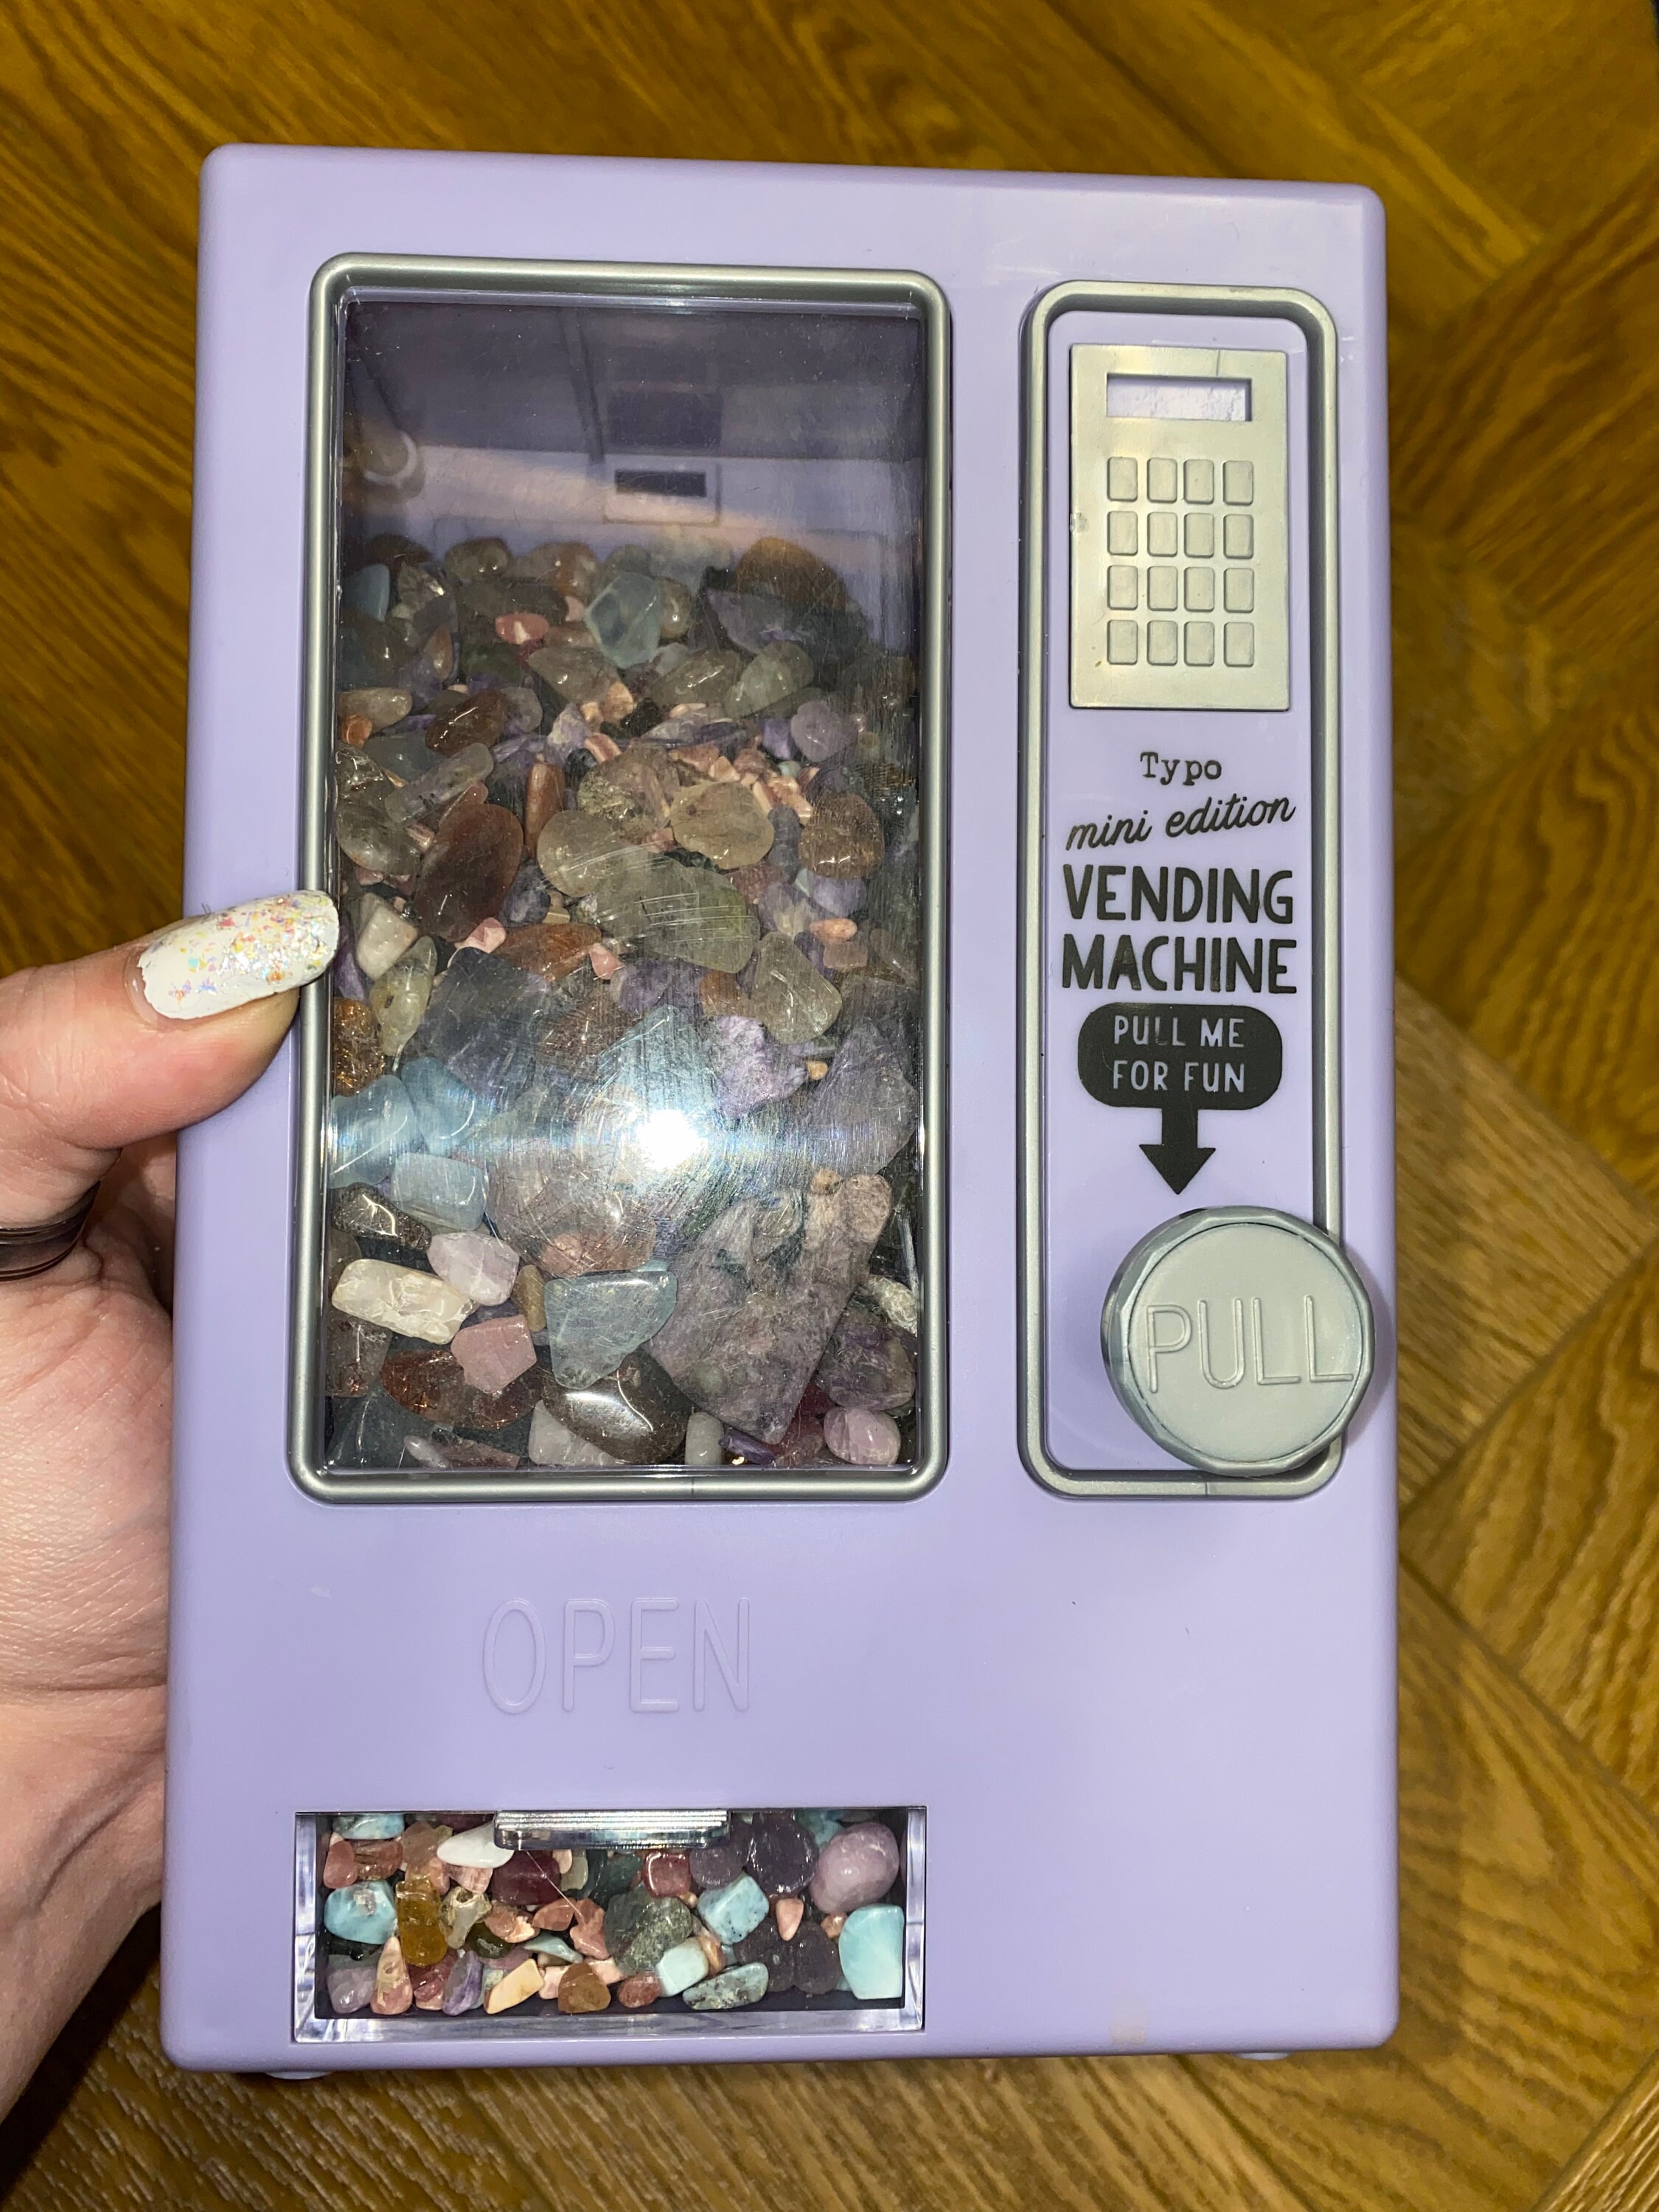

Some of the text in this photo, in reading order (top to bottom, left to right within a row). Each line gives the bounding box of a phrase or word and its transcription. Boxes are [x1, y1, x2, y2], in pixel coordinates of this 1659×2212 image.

[1139, 751, 1222, 786] Typo
[1065, 793, 1297, 851] mini edition
[1062, 863, 1294, 925] VENDING
[1061, 933, 1298, 995] MACHINE
[1113, 1014, 1246, 1048] PULL ME
[1112, 1060, 1246, 1093] FOR FUN
[1145, 1294, 1355, 1394] PULL
[482, 1597, 751, 1716] OPEN
